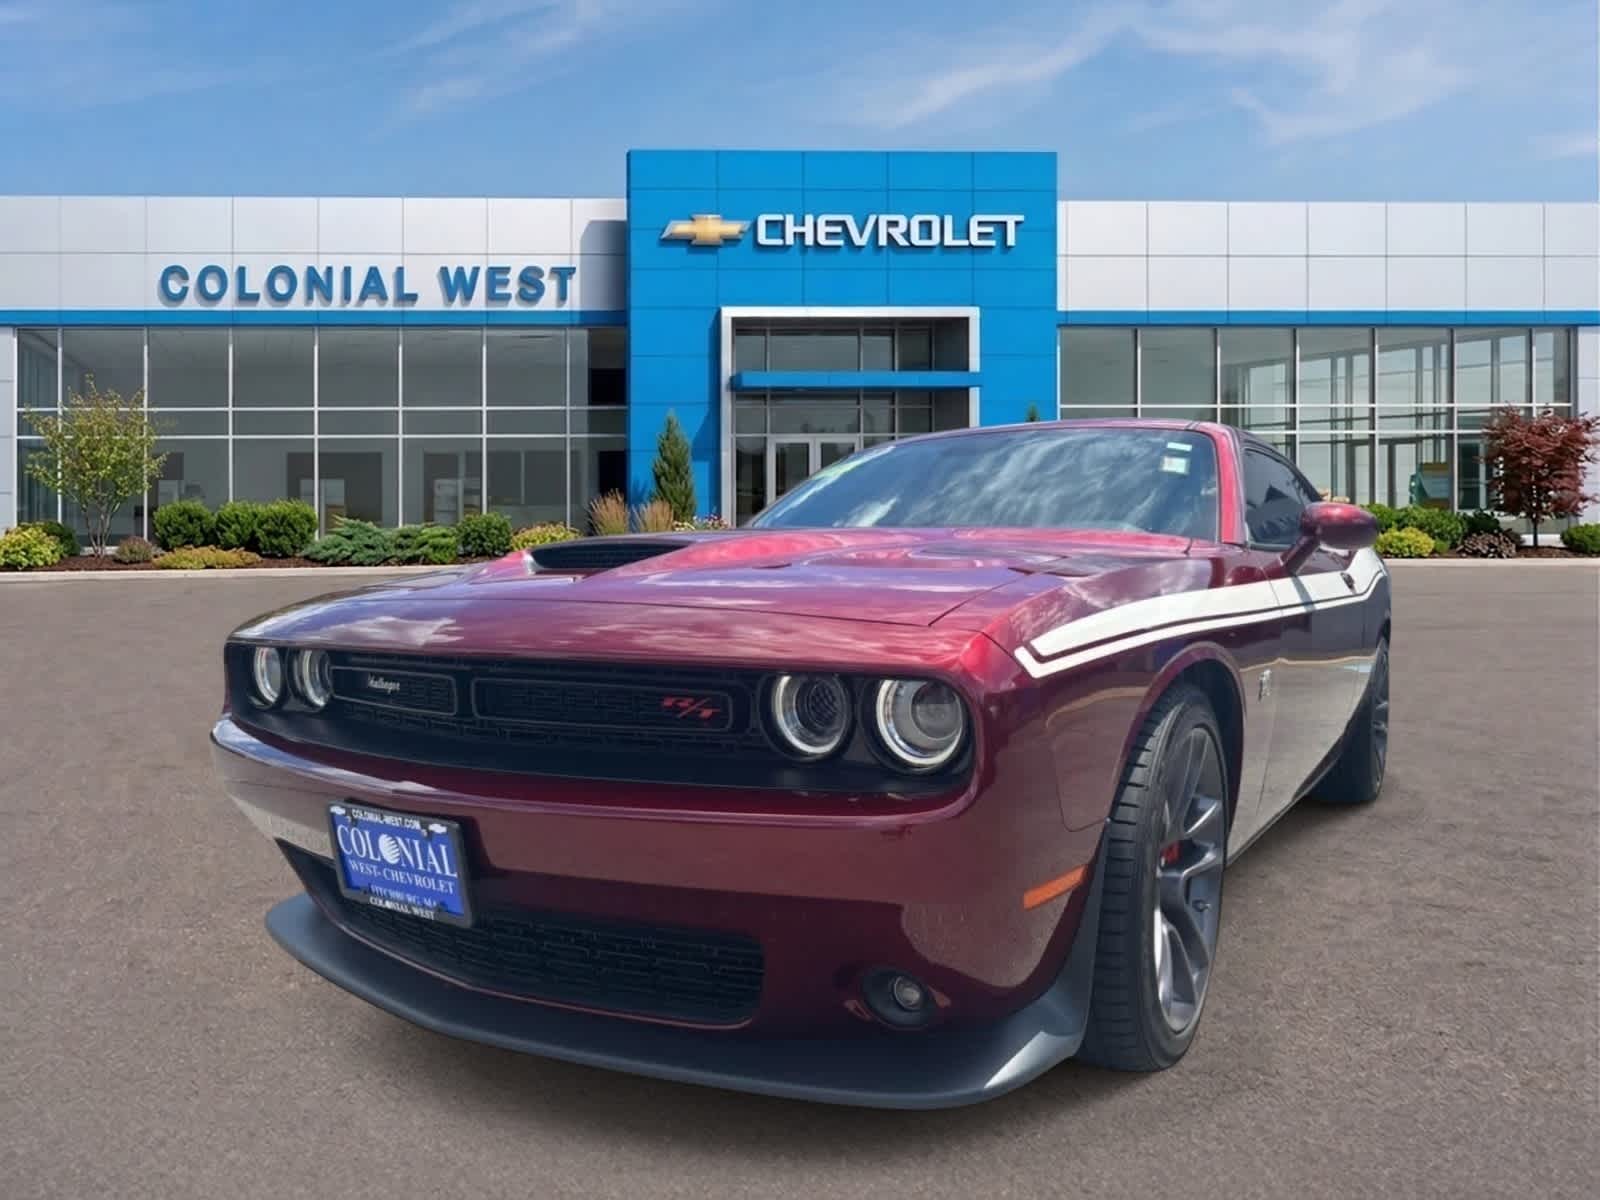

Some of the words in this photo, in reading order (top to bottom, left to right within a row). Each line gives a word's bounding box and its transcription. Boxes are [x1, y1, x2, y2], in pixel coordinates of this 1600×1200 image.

[756, 213, 1025, 247] CHEVROLET
[158, 265, 419, 305] COLONIAL
[438, 265, 577, 305] WEST
[336, 824, 458, 879] COLONIAL
[411, 906, 435, 920] WEST
